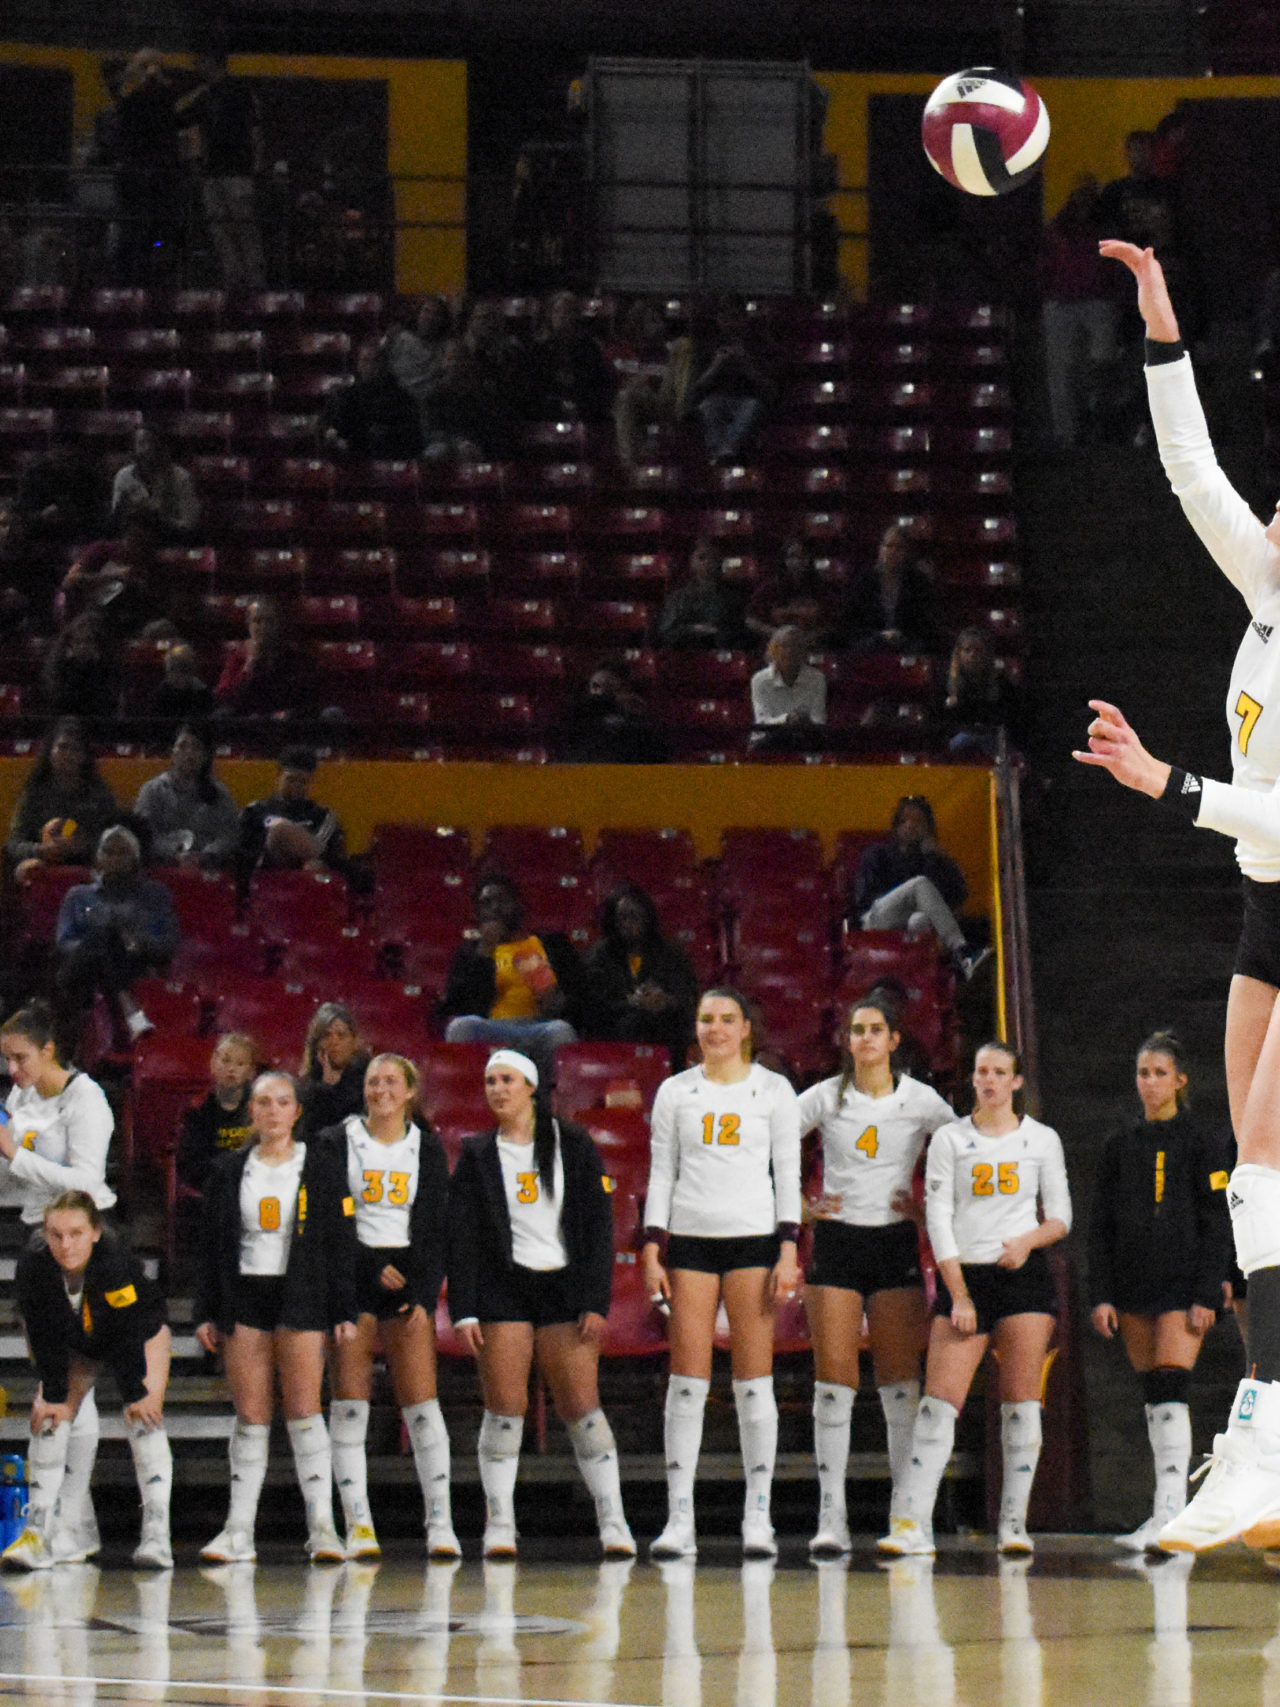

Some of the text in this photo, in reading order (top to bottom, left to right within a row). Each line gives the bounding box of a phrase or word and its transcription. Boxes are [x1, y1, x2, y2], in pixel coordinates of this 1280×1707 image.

[1235, 690, 1264, 757] 7
[702, 1113, 741, 1145] 12
[856, 1125, 879, 1158] 4
[362, 1169, 411, 1205] 33
[516, 1172, 539, 1203] 3
[971, 1162, 1020, 1196] 25
